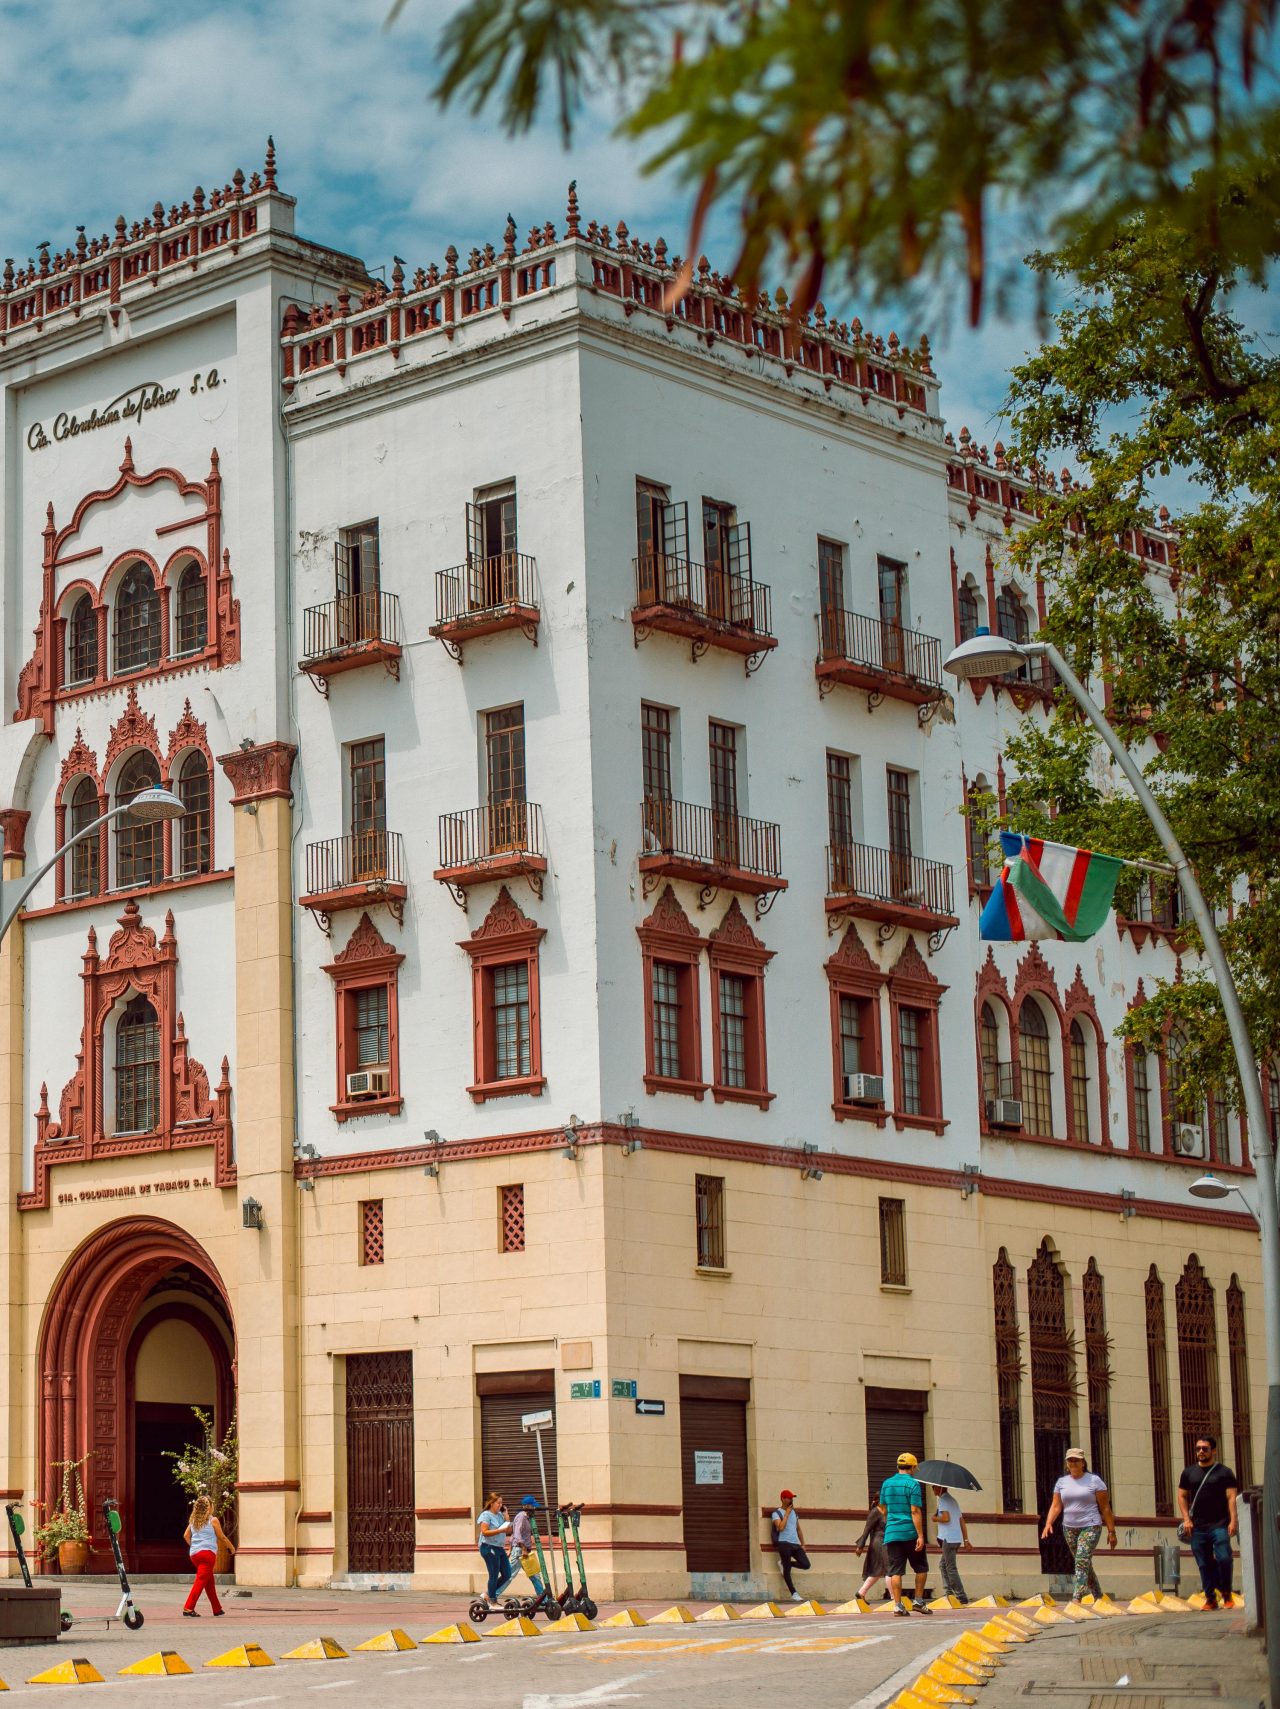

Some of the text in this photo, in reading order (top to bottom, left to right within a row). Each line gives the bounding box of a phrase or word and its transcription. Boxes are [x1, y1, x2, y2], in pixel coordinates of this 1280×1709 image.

[53, 409, 120, 440] Colombiana
[122, 399, 136, 418] de
[58, 1178, 212, 1203] CIA. COLOMBIANA DE TABACO S.A.
